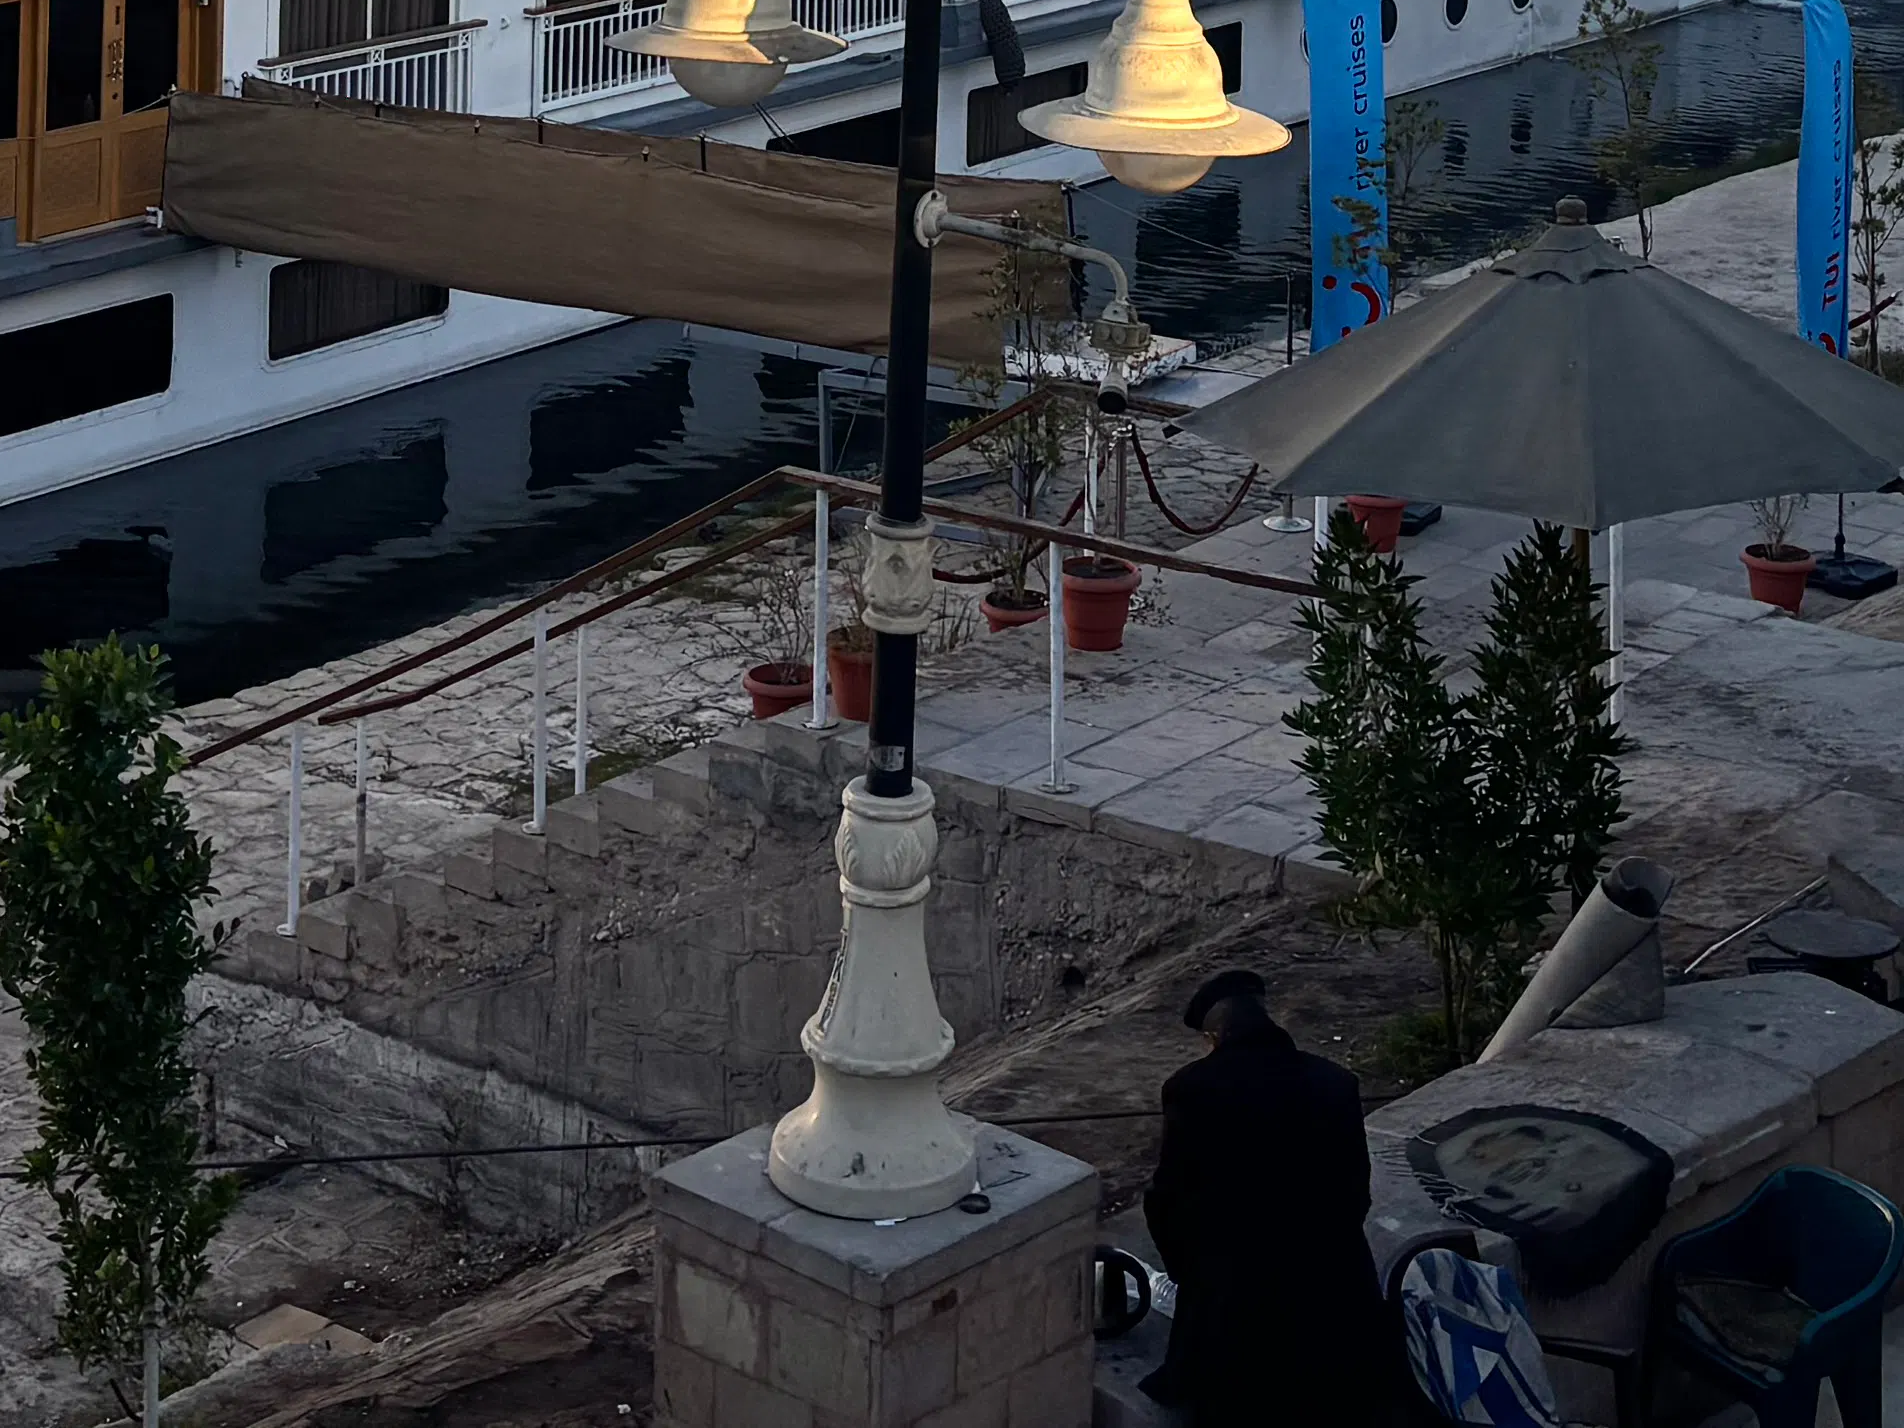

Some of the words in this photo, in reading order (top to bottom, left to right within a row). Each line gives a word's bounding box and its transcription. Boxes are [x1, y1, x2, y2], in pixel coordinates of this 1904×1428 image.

[1347, 15, 1369, 115] cruises
[1831, 59, 1842, 163] cruises
[1831, 177, 1841, 240] river
[1822, 251, 1840, 312] TUI
